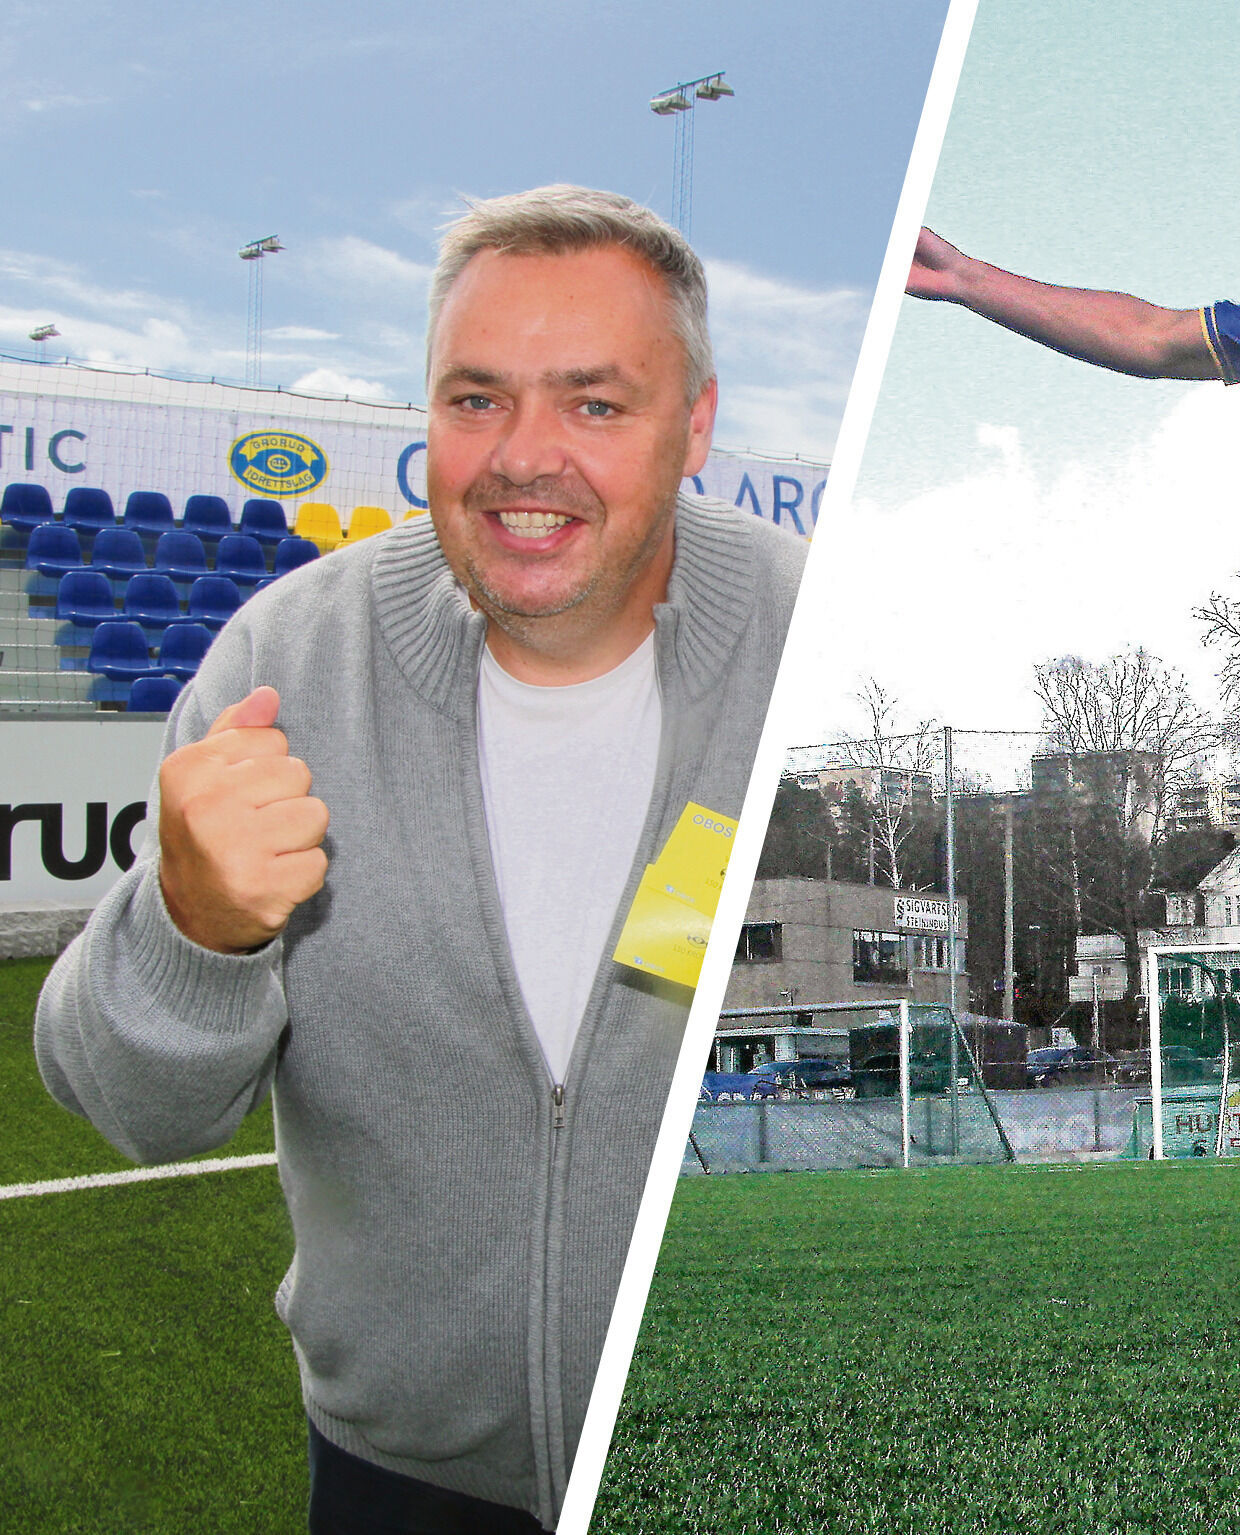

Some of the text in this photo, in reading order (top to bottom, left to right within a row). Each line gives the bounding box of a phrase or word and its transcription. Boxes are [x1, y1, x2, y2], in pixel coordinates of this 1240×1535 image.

[252, 438, 306, 452] GRORUD
[246, 469, 313, 489] IDRETTSLAG
[692, 813, 734, 839] OBOS
